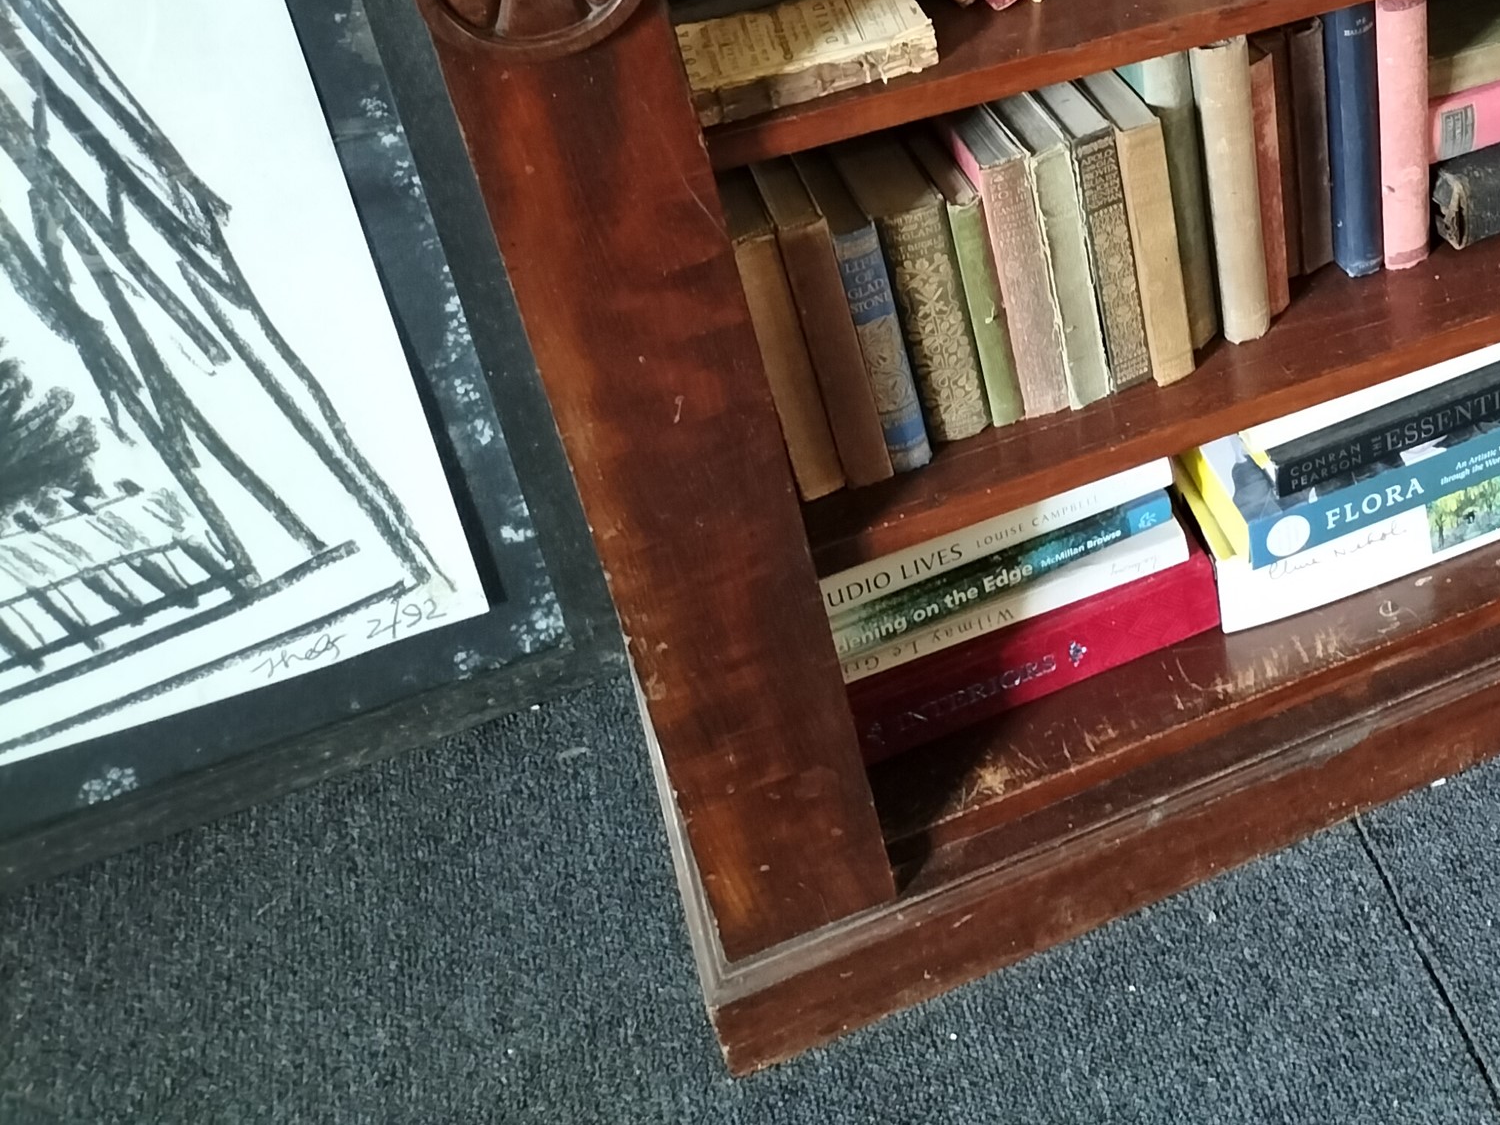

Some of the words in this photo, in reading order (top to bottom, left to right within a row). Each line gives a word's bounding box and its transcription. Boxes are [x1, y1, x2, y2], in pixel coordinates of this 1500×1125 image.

[1289, 442, 1361, 477] CONRAN
[1371, 434, 1383, 457] THE
[1455, 460, 1468, 471] An
[1468, 447, 1497, 466] Artistic
[1291, 453, 1363, 491] PEARSON
[1440, 468, 1471, 486] through
[1471, 461, 1484, 472] the
[1325, 477, 1425, 530] FLORA
[900, 543, 964, 580] LIVES
[975, 523, 1025, 549] LOUISE
[1031, 495, 1100, 527] CAMPBELL
[912, 604, 941, 623] on
[943, 585, 979, 609] the
[982, 562, 1034, 595] Edge
[1040, 544, 1086, 569] McMillan
[1086, 528, 1123, 550] Browse
